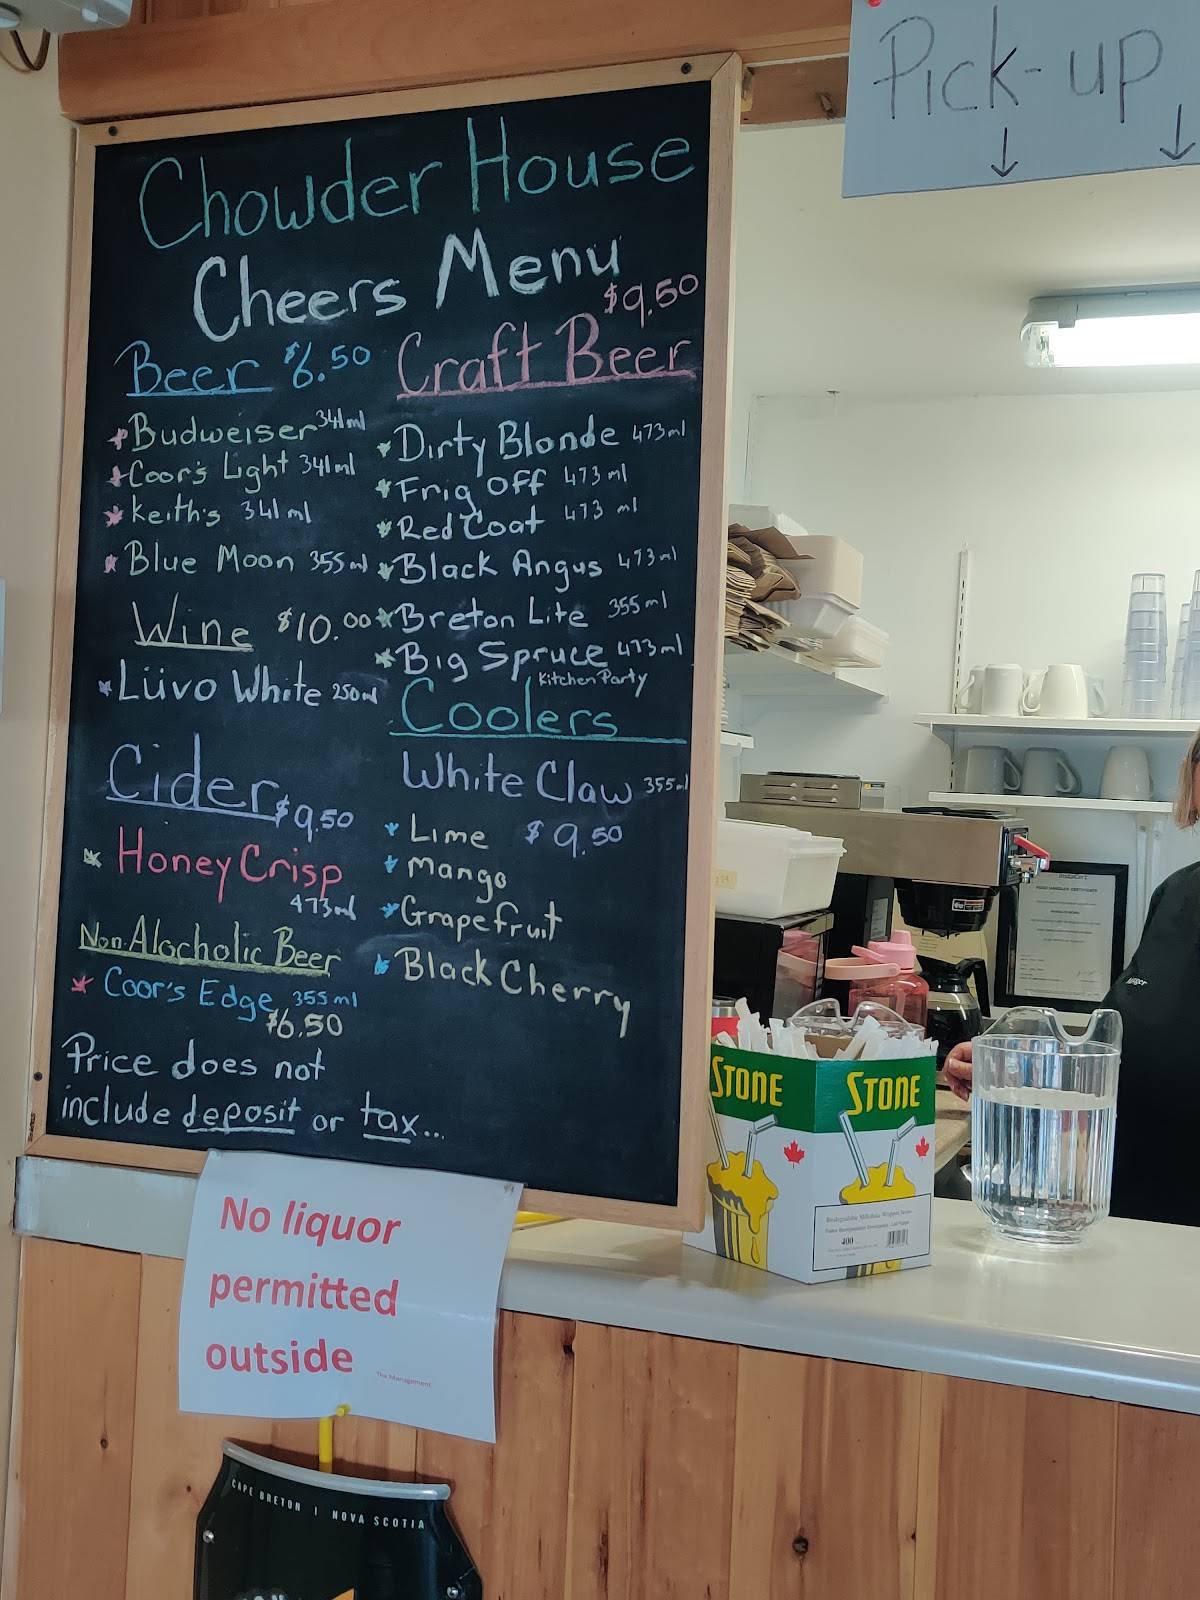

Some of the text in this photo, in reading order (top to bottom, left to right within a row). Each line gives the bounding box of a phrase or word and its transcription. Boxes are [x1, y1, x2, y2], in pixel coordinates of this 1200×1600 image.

[139, 116, 696, 249] Chowder House
[193, 227, 621, 342] Cheers Menu
[604, 274, 698, 328] $9.50
[113, 340, 371, 396] Beer $6.50
[397, 312, 693, 396] Craft Beer
[128, 411, 318, 452] Budweiser
[393, 419, 486, 479] Dirty
[498, 414, 621, 461] Blonde
[129, 459, 208, 488] Coor's
[223, 449, 289, 495] Light
[395, 476, 481, 518] Frig
[396, 511, 453, 541] Red
[461, 504, 547, 541] Coat
[123, 540, 198, 577] Blue
[216, 543, 294, 574] Moon
[391, 549, 499, 585] Black
[512, 548, 603, 594] Angus
[131, 591, 372, 650] Wine $10.00
[394, 596, 515, 635] Breton
[528, 595, 590, 629] Lite
[119, 658, 217, 703] Lüvo
[231, 659, 322, 707] White
[394, 641, 470, 684] Big
[477, 640, 609, 683] Spruce
[538, 667, 649, 700] Kitchen Party
[400, 676, 619, 739] Coolers
[109, 731, 281, 810] Cider
[402, 750, 525, 799] White
[536, 759, 634, 805] Claw
[274, 794, 355, 843] $9.50
[410, 813, 490, 851] Lime
[400, 894, 564, 943] Grapefruit
[272, 925, 342, 977] Beer
[103, 965, 186, 1003] Coor's
[197, 978, 276, 1023] Edge
[393, 946, 631, 1039] Black Cherry
[265, 1007, 345, 1040] $6.50
[60, 1031, 326, 1082] Price does not
[60, 1083, 172, 1128] include
[182, 1093, 303, 1136] deposit
[311, 1109, 345, 1133] or
[220, 1195, 402, 1248] No liquor
[208, 1271, 400, 1318] permitted
[205, 1337, 353, 1375] outside
[231, 1477, 255, 1498] CAPE
[259, 1489, 302, 1512] BRETON
[332, 1509, 366, 1525] NOVA
[373, 1515, 426, 1530] SCOTIA
